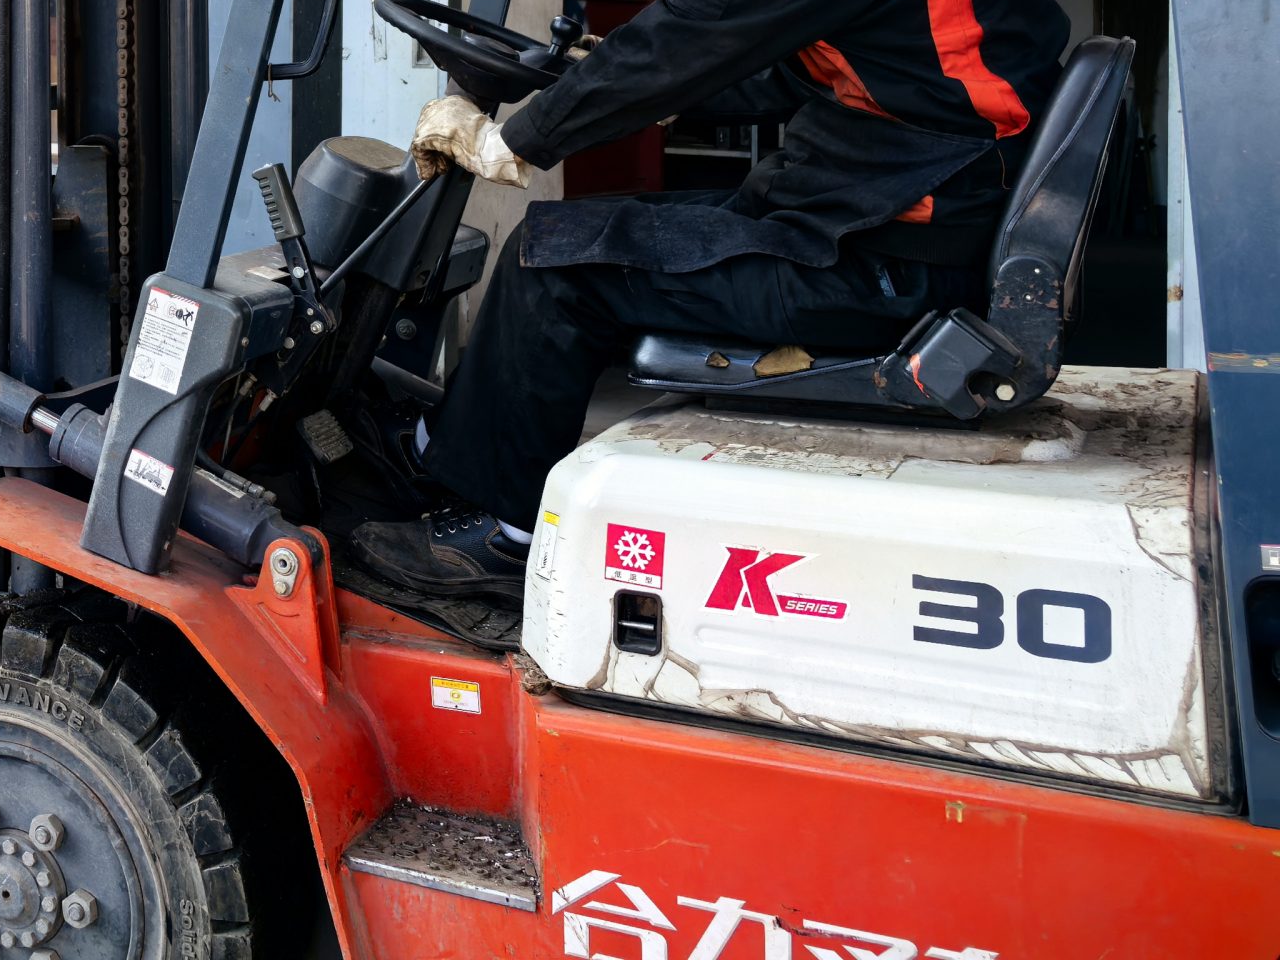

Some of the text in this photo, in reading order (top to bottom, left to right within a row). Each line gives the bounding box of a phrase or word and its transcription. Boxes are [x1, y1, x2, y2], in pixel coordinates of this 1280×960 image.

[705, 547, 839, 617] K SERIES
[912, 574, 1113, 664] 30
[552, 869, 1000, 960] 合力
